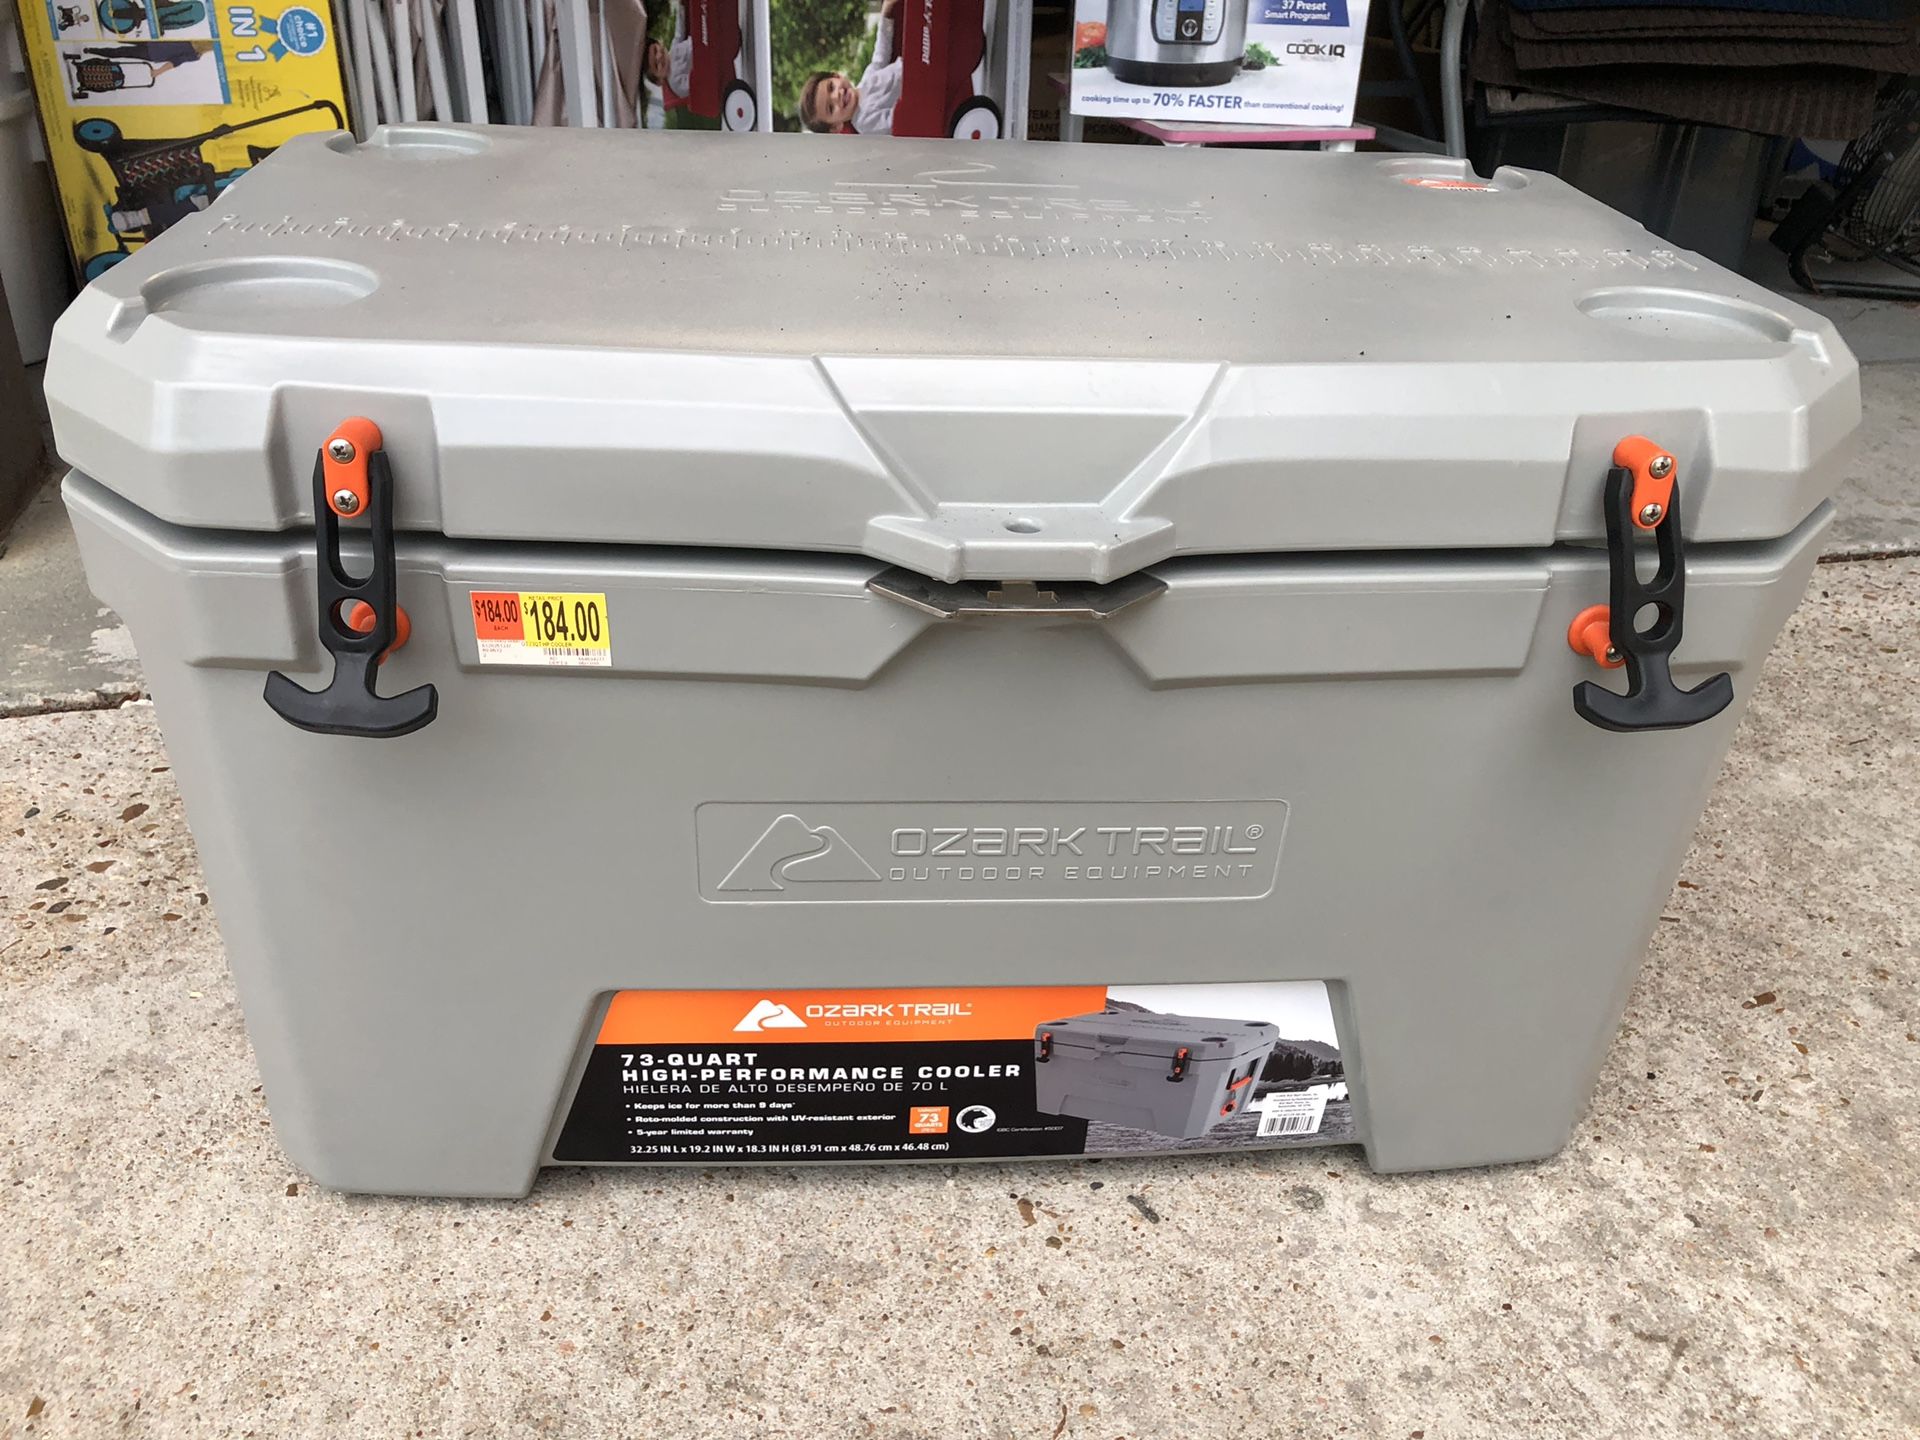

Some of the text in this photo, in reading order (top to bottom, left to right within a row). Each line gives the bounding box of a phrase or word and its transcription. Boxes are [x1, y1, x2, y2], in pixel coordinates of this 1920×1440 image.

[1281, 0, 1328, 11] 37 Preset
[228, 7, 258, 36] IN
[1265, 10, 1331, 21] Smart Programs!
[1286, 43, 1345, 57] COOK IQ
[1081, 95, 1111, 104] cooking
[1153, 93, 1184, 107] 70%
[1188, 95, 1243, 109] FASTER
[1262, 102, 1310, 110] conventional
[1312, 104, 1344, 113] cooking!
[475, 600, 518, 623] $184.00
[523, 601, 600, 641] $184.00
[891, 826, 1087, 857] OZARK
[889, 864, 1255, 881] OUTDOOR EQUIPMENT
[805, 1004, 894, 1018] OZARK
[620, 1053, 758, 1067] 73-QUART
[622, 1064, 1021, 1082] HIGH-PERFORMANCE COOLER
[623, 1080, 949, 1094] HIELERA DE ALTO DESEMPEÑO DE 70 L
[634, 1102, 666, 1110] Keeps
[700, 1114, 764, 1122] construction
[766, 1114, 789, 1122] with
[919, 1113, 940, 1123] 73
[637, 1128, 754, 1137] 5-year limited warranty
[630, 1145, 658, 1154] 32.25
[660, 1145, 671, 1153] IN
[690, 1145, 711, 1153] 19.2
[713, 1145, 723, 1153] IN
[725, 1145, 736, 1153] W
[746, 1144, 767, 1153] 18.3
[769, 1144, 780, 1152] IN
[782, 1144, 789, 1152] H
[791, 1144, 822, 1153] (81.91
[849, 1144, 876, 1152] 48.76
[878, 1144, 892, 1152] cm
[902, 1143, 929, 1151] 46.48
[931, 1143, 950, 1152] cm)
